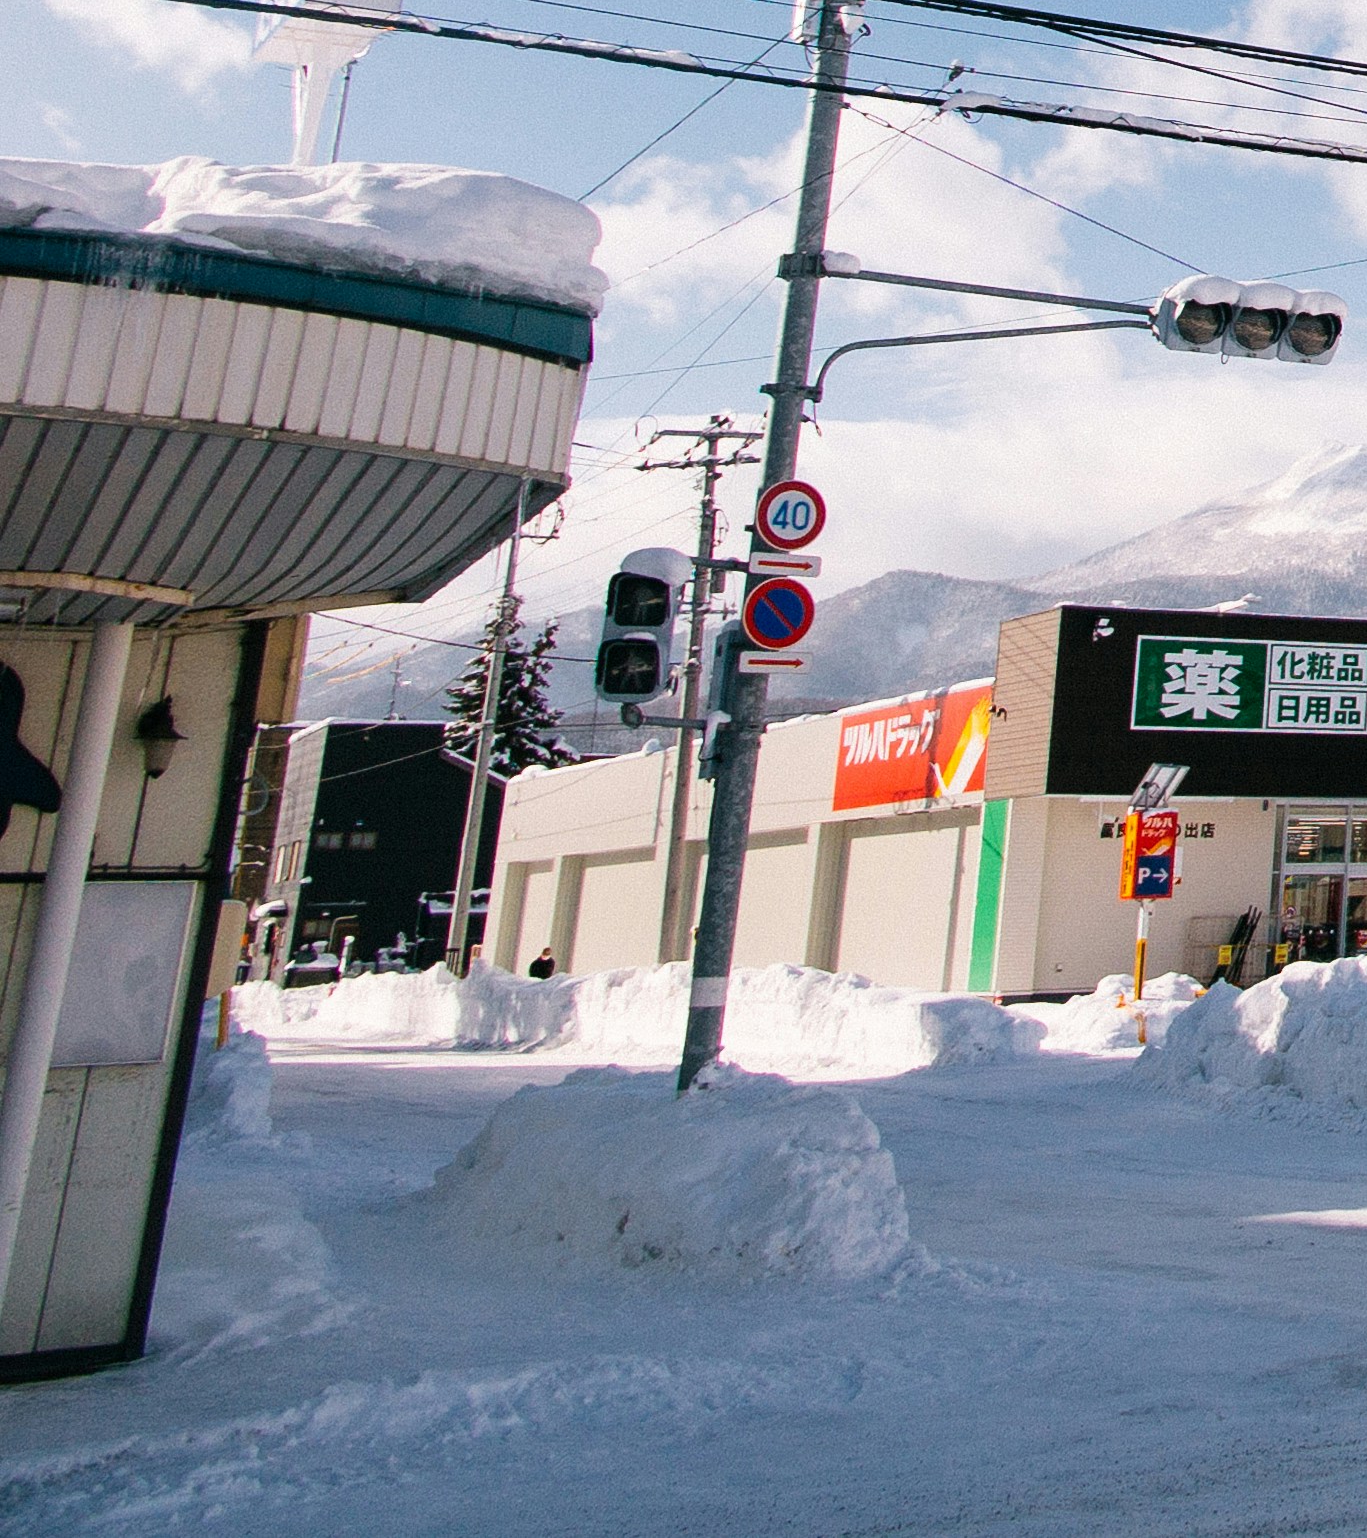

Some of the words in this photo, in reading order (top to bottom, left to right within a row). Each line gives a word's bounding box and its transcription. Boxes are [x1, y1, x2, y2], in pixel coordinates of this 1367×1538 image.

[772, 500, 811, 530] 40
[1277, 651, 1363, 682] 化粧品
[1160, 649, 1243, 719] 薬
[1277, 695, 1361, 725] 日用品
[843, 709, 941, 767] ツルハドラッグ
[1138, 867, 1152, 884] P
